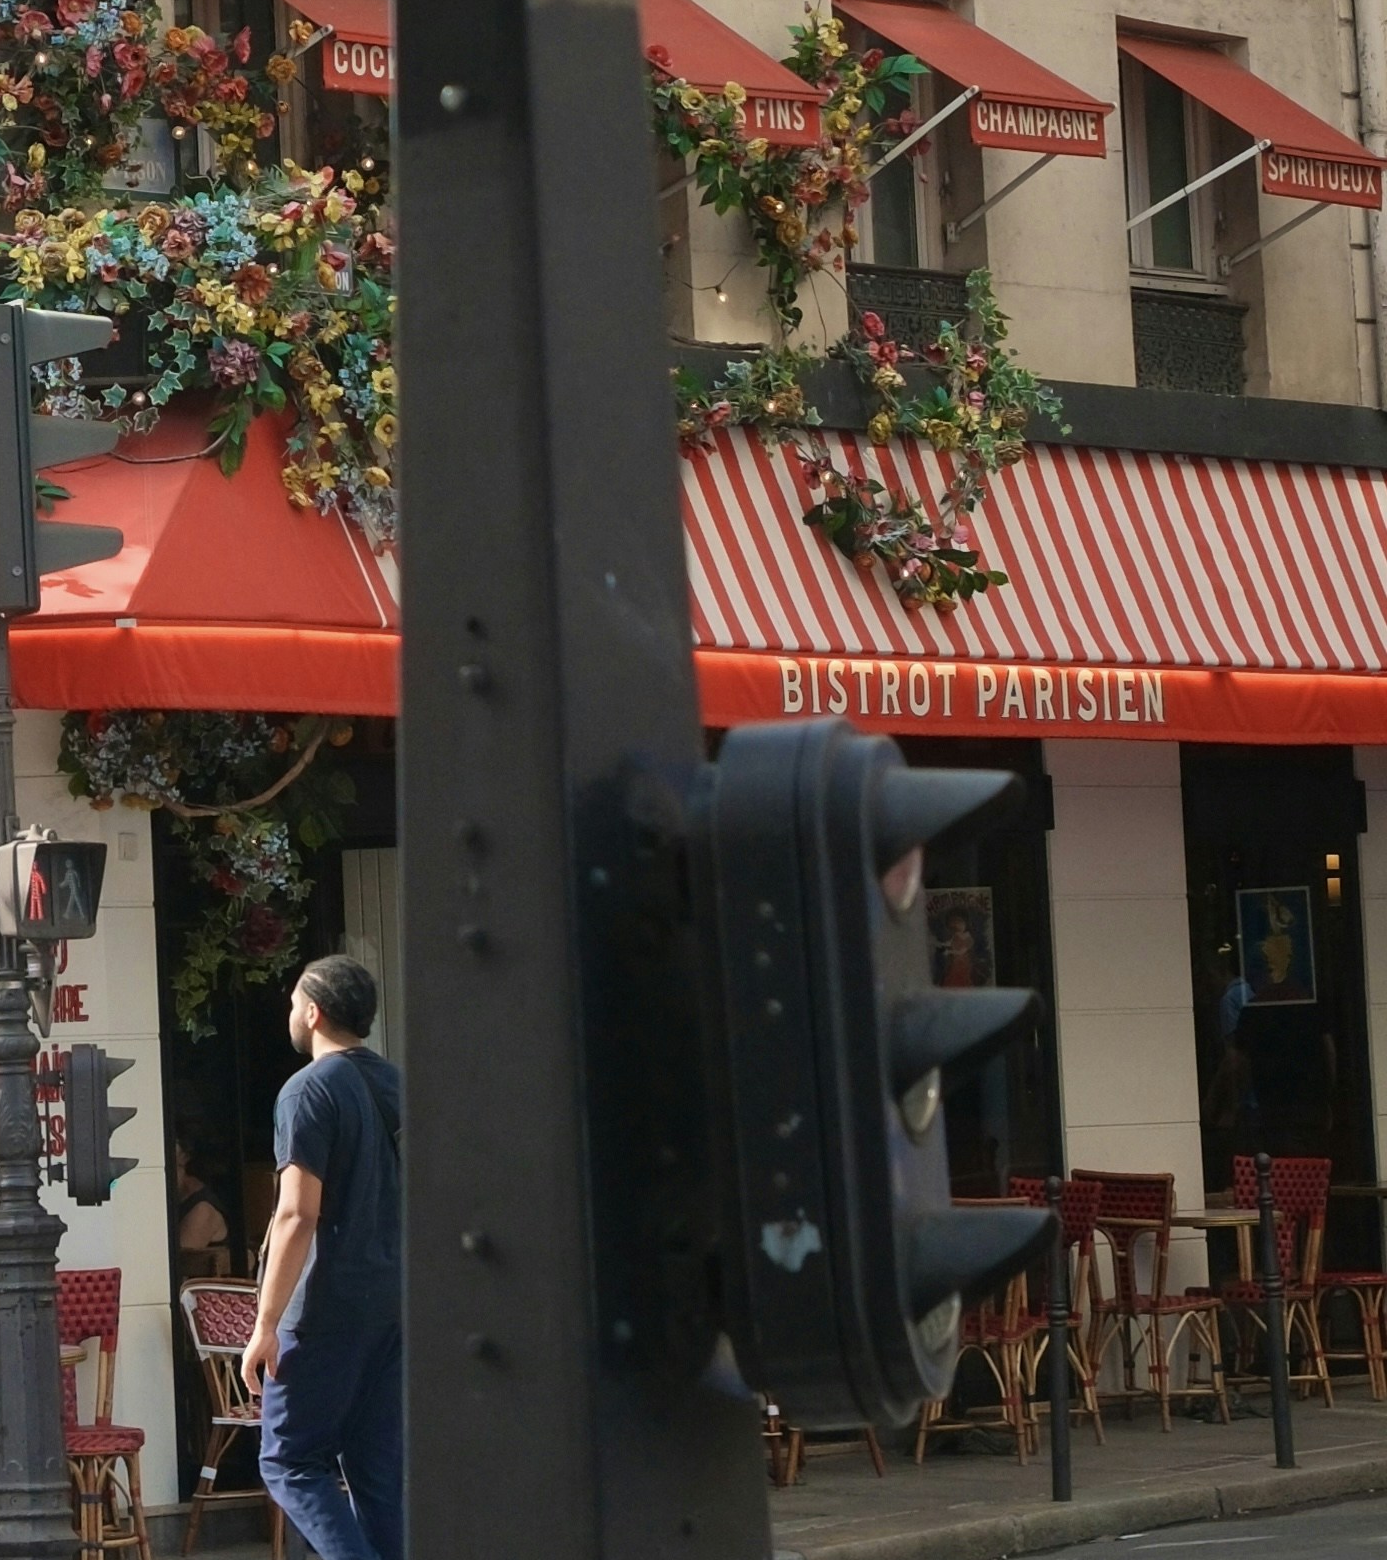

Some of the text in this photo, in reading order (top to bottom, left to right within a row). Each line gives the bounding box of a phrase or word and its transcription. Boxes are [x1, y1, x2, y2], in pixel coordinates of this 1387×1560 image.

[755, 98, 805, 130] FINS
[976, 101, 1098, 142] CHAMPAGNE
[1268, 153, 1377, 195] SPIRITUEUX
[778, 657, 1166, 723] BISTROT PARISIEN
